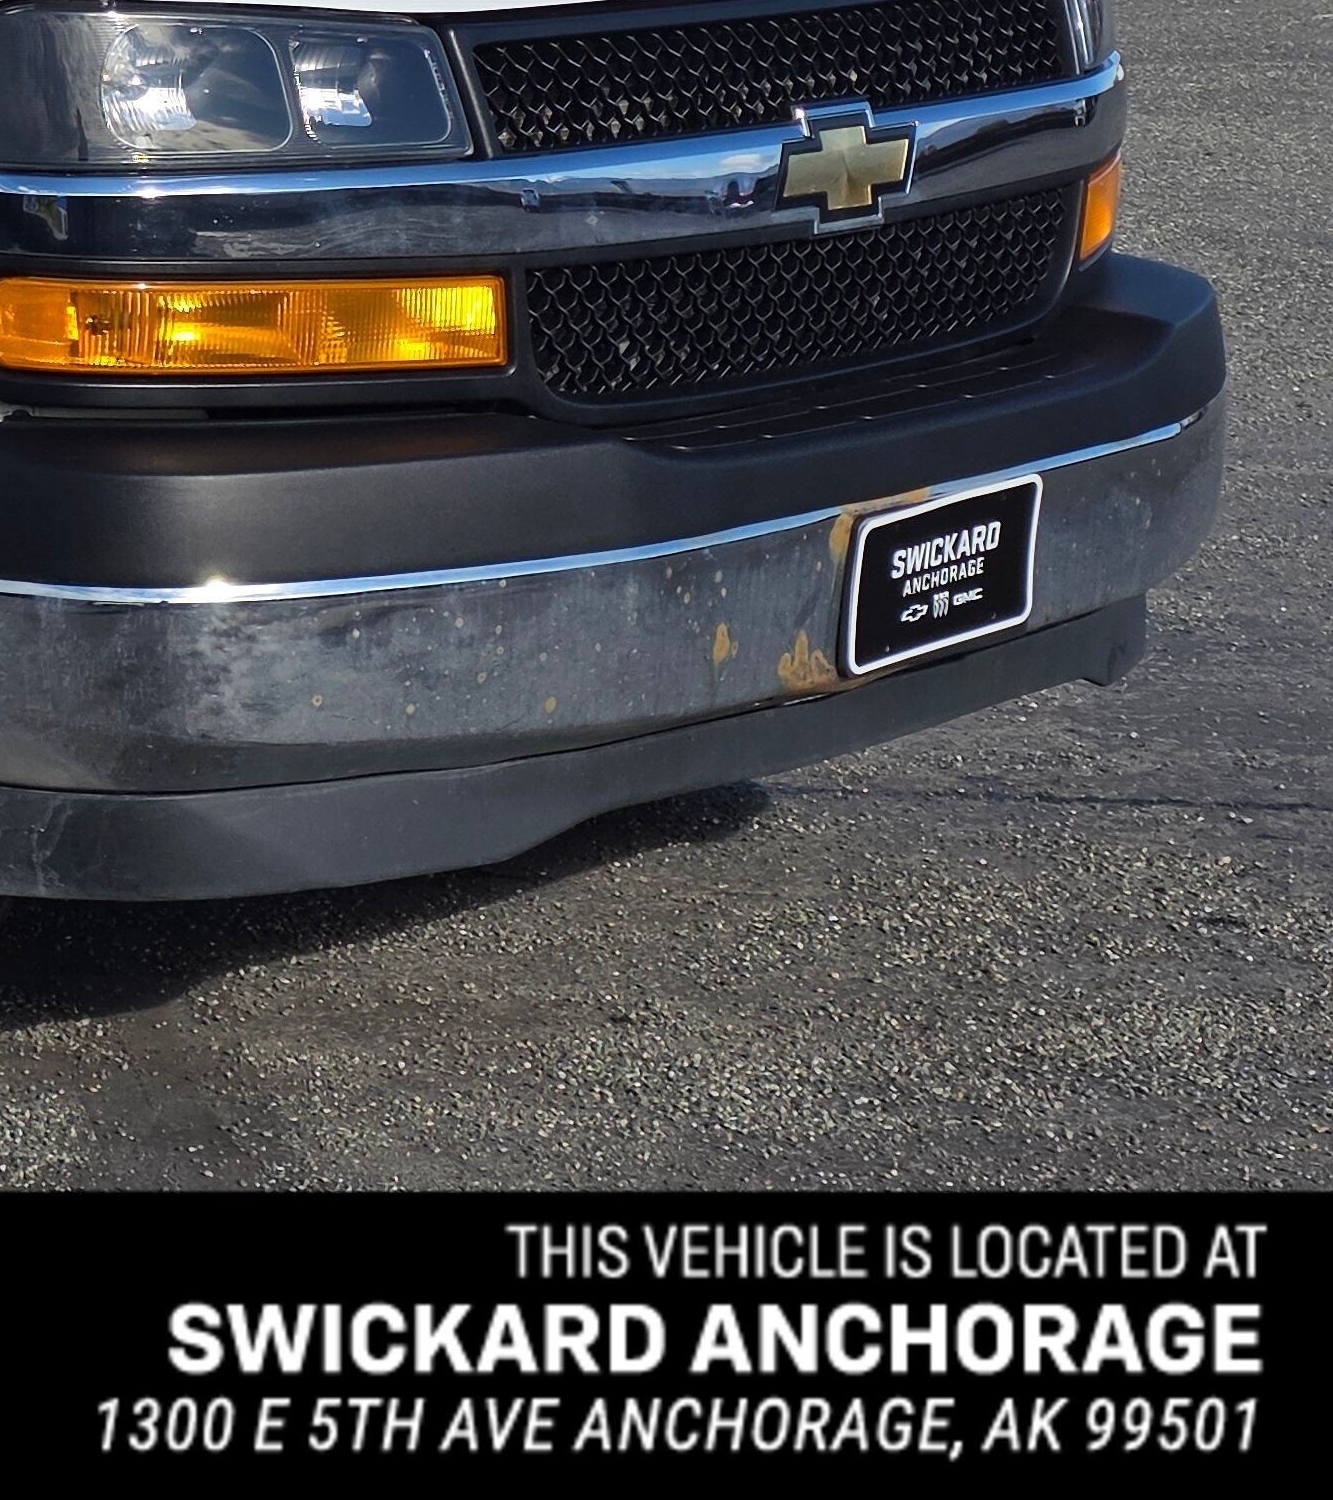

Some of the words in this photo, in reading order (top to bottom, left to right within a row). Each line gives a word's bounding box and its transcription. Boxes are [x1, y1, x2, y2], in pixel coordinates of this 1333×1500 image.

[891, 521, 1001, 579] SWICKARD
[902, 557, 985, 597] ANCHORAGE
[952, 587, 983, 606] GMC
